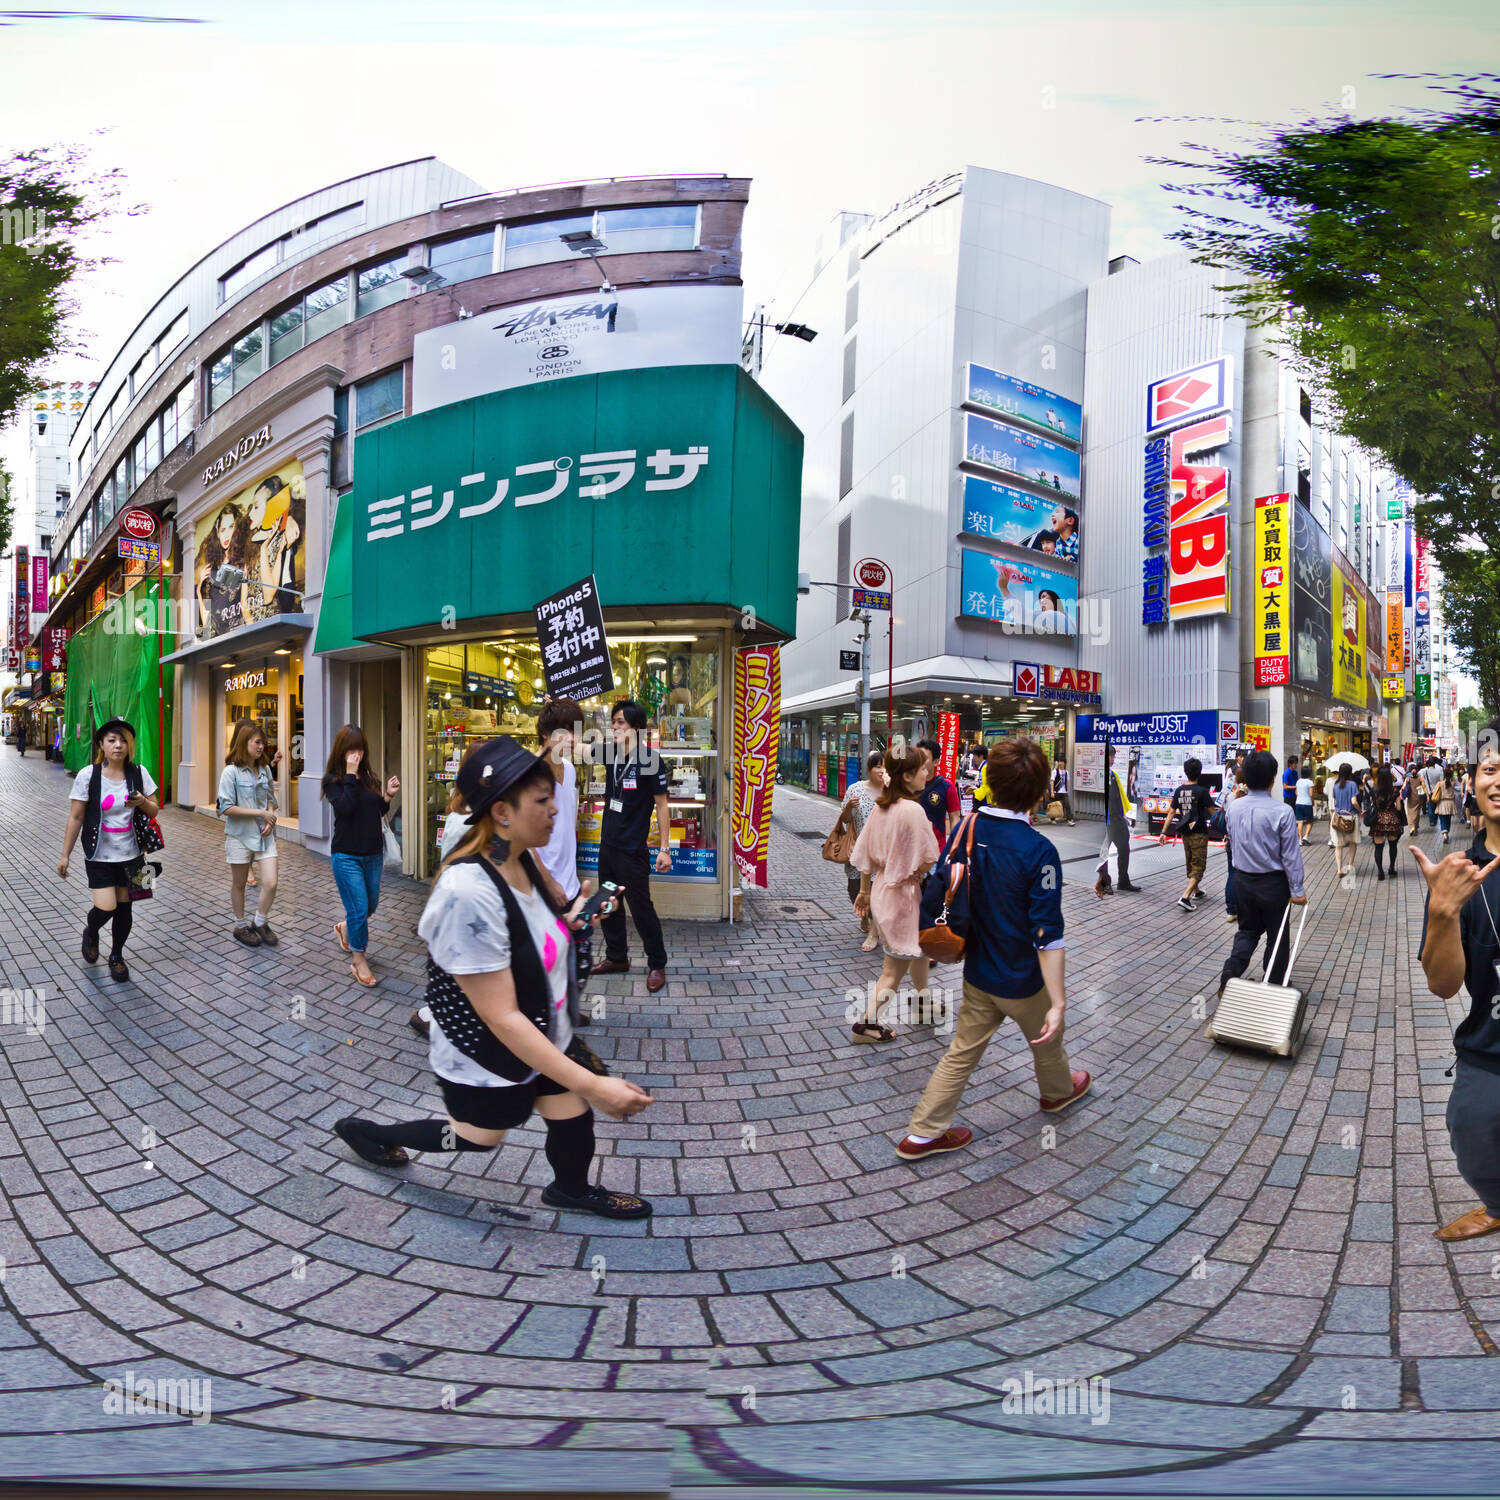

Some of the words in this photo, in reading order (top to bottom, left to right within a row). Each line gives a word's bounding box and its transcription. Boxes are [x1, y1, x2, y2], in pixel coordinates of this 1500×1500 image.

[514, 336, 534, 344] LOS
[538, 325, 600, 340] ANGELES
[524, 326, 546, 336] NEW
[549, 322, 587, 332] YORK
[536, 334, 579, 345] TOKYO
[528, 359, 581, 373] LONDON
[536, 367, 574, 378] PARIS
[203, 424, 271, 486] RANDA
[367, 446, 708, 541] ミシンプラザ
[1143, 438, 1166, 548] SHINJUKU
[1265, 497, 1280, 506] 4F
[128, 518, 152, 531] 消火栓
[1170, 416, 1230, 622] LABI
[1264, 507, 1282, 562] 質・買取
[862, 568, 884, 581] 消火栓
[1262, 567, 1282, 587] 質
[1143, 554, 1166, 626] 東口館
[221, 592, 264, 620] RANDA
[537, 582, 593, 622] iPhone5
[548, 606, 585, 640] 予約
[1264, 591, 1282, 652] 大黒屋
[545, 625, 600, 667] 受付中
[1416, 628, 1430, 661] 大勝軒
[842, 652, 857, 660] モア
[1260, 659, 1285, 667] DUTY
[1338, 640, 1362, 678] 大黒屋
[1043, 664, 1102, 693] LABI
[1260, 667, 1284, 676] FREE
[1260, 675, 1286, 684] SHOP
[225, 672, 264, 692] RANDA
[1419, 676, 1427, 696] レイク
[1044, 689, 1081, 702] SHINJUKU
[1115, 719, 1139, 733] Your
[1147, 715, 1188, 733] JUST
[735, 654, 771, 851] ミシンセール
